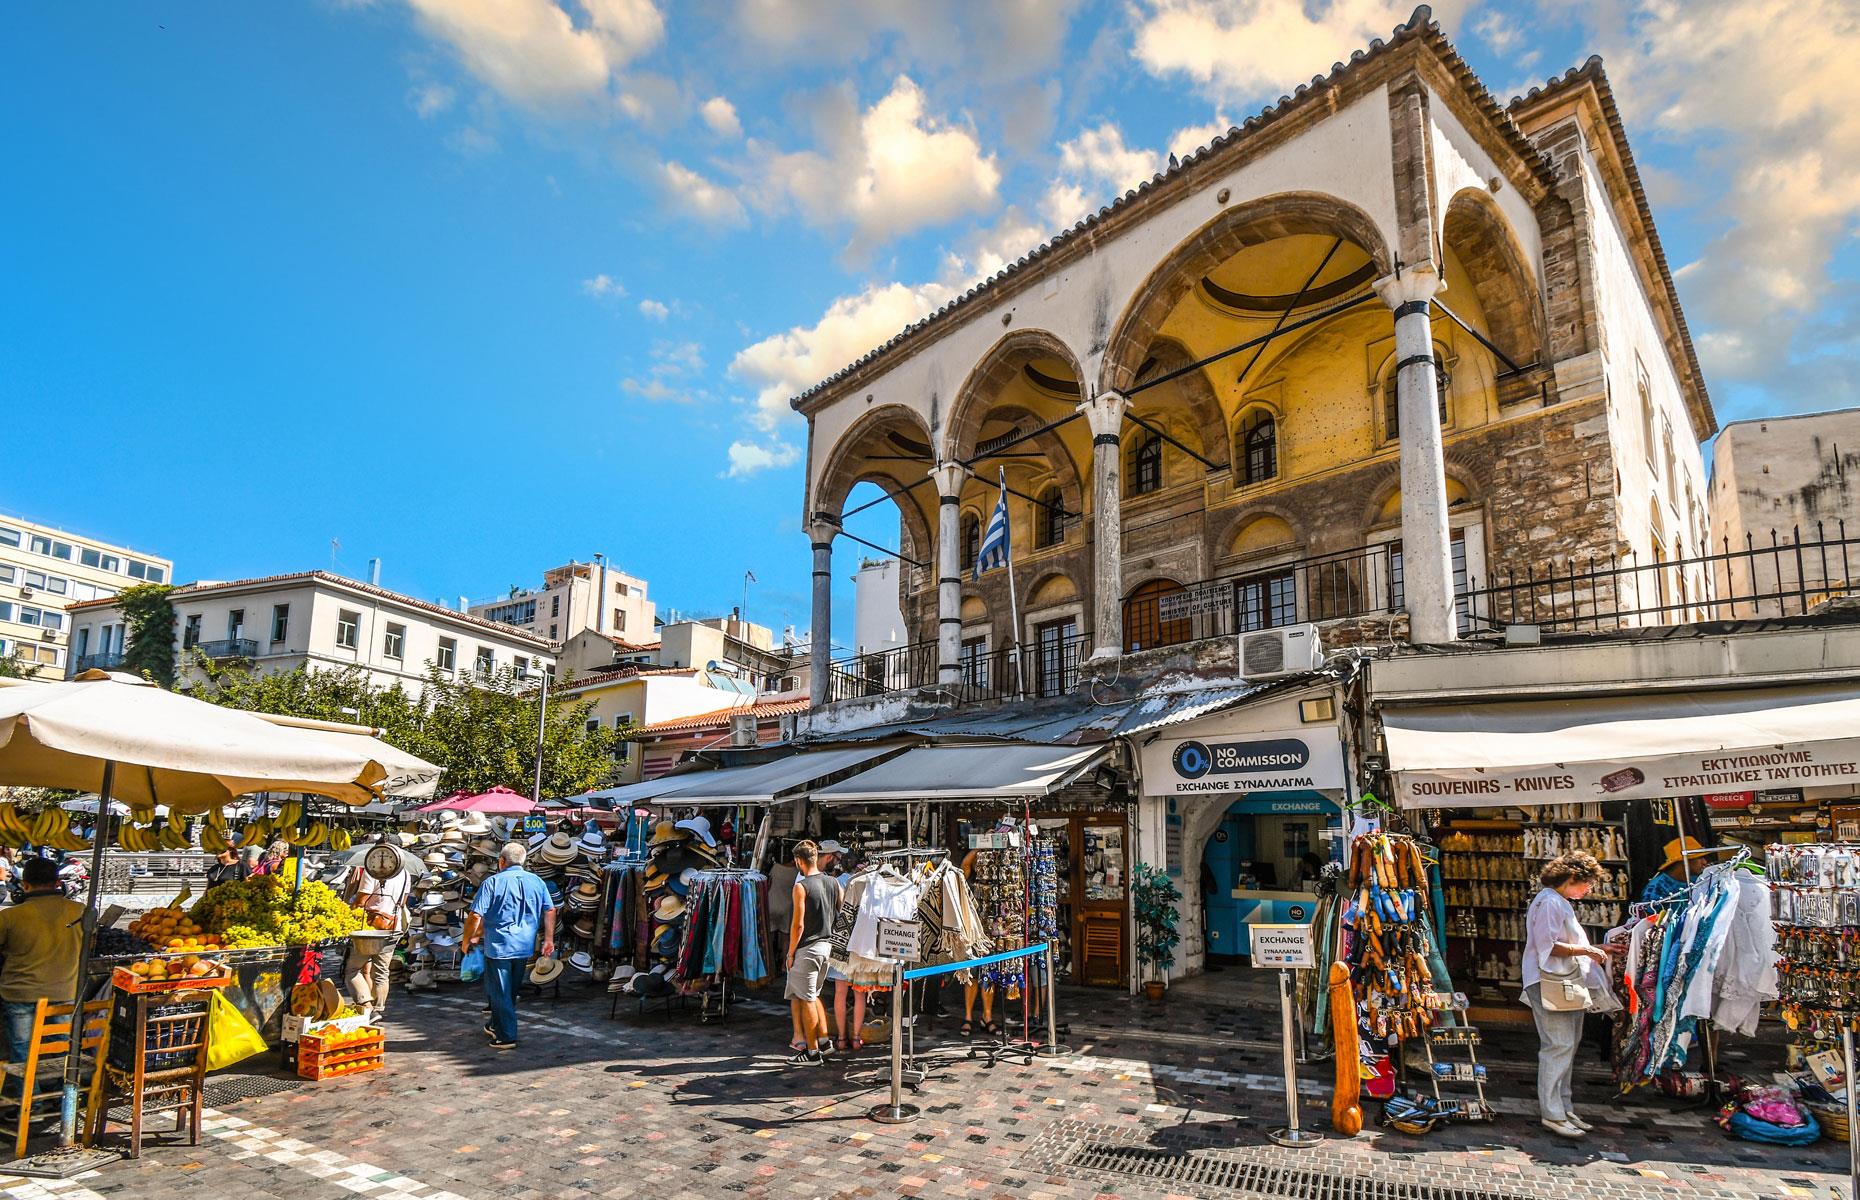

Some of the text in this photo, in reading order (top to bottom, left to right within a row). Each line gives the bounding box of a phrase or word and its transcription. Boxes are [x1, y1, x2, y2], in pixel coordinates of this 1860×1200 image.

[1216, 748, 1236, 758] NO
[1181, 748, 1209, 773] 0%
[1217, 753, 1302, 768] COMMISSION
[1701, 750, 1813, 771] ΕΚΤΥΠΩΝΟΥΜΕ
[1663, 762, 1859, 788] ΣΤΡΑΤΙΩΤΙΚΕΣ ΤΑΥΤΟΤΗΤΕΣ
[1176, 777, 1314, 791] EXCHANGE ΣΥΝΑΛΛΑΓΜΑ
[1412, 779, 1500, 796] SOUVENIRS
[1514, 775, 1575, 792] KNIVES
[1712, 794, 1745, 802] GREECE
[1271, 803, 1321, 811] EXCHANGE
[884, 929, 915, 938] EXCHANGE
[1260, 936, 1304, 944] EXCHANGE
